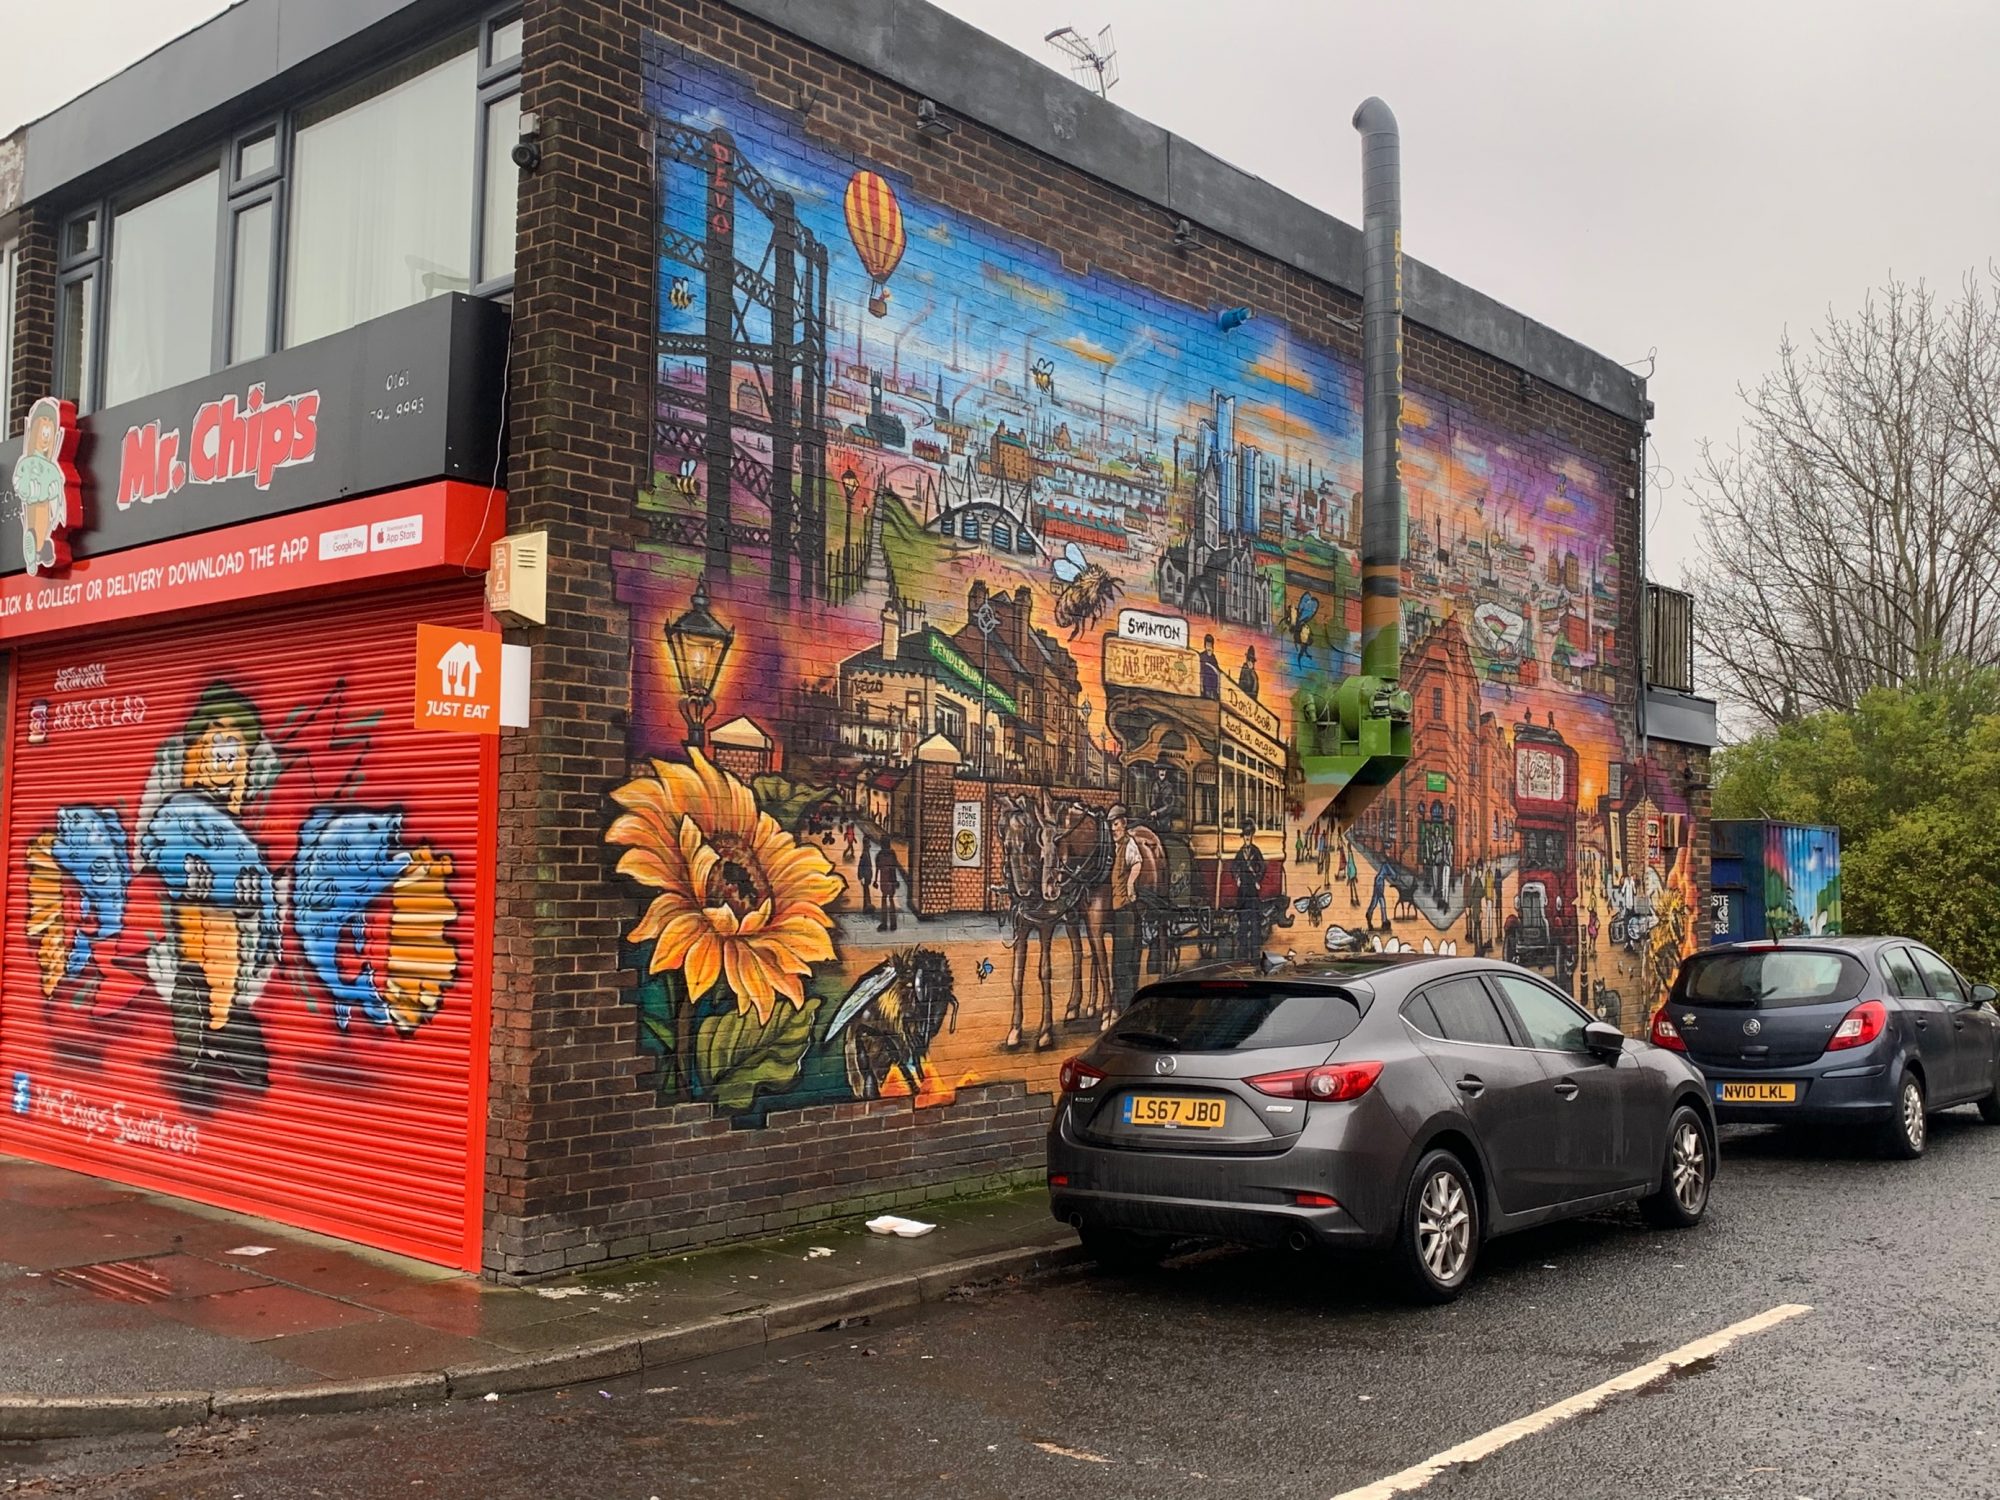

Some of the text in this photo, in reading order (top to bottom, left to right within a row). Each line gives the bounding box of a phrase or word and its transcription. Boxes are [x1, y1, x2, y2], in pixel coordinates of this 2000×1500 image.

[712, 143, 730, 233] DEVO
[117, 382, 320, 511] Mr. Chips
[400, 530, 417, 540] Store
[0, 592, 22, 618] LICK
[37, 583, 83, 610] COLLECT
[86, 578, 103, 602] OR
[106, 566, 165, 599] DELIVERY
[168, 551, 245, 587] DOWNLOAD
[248, 543, 276, 571] THE
[279, 535, 310, 566] APP
[1127, 617, 1181, 641] SWINTON
[931, 635, 982, 688] PENDLEBURY
[1144, 653, 1172, 675] CHIPS
[425, 700, 490, 719] JUST EAT
[1228, 688, 1252, 716] Don't
[957, 812, 977, 820] STONE
[1724, 1085, 1787, 1098] NV10 LKL
[1134, 1100, 1221, 1122] LS67 JBO
